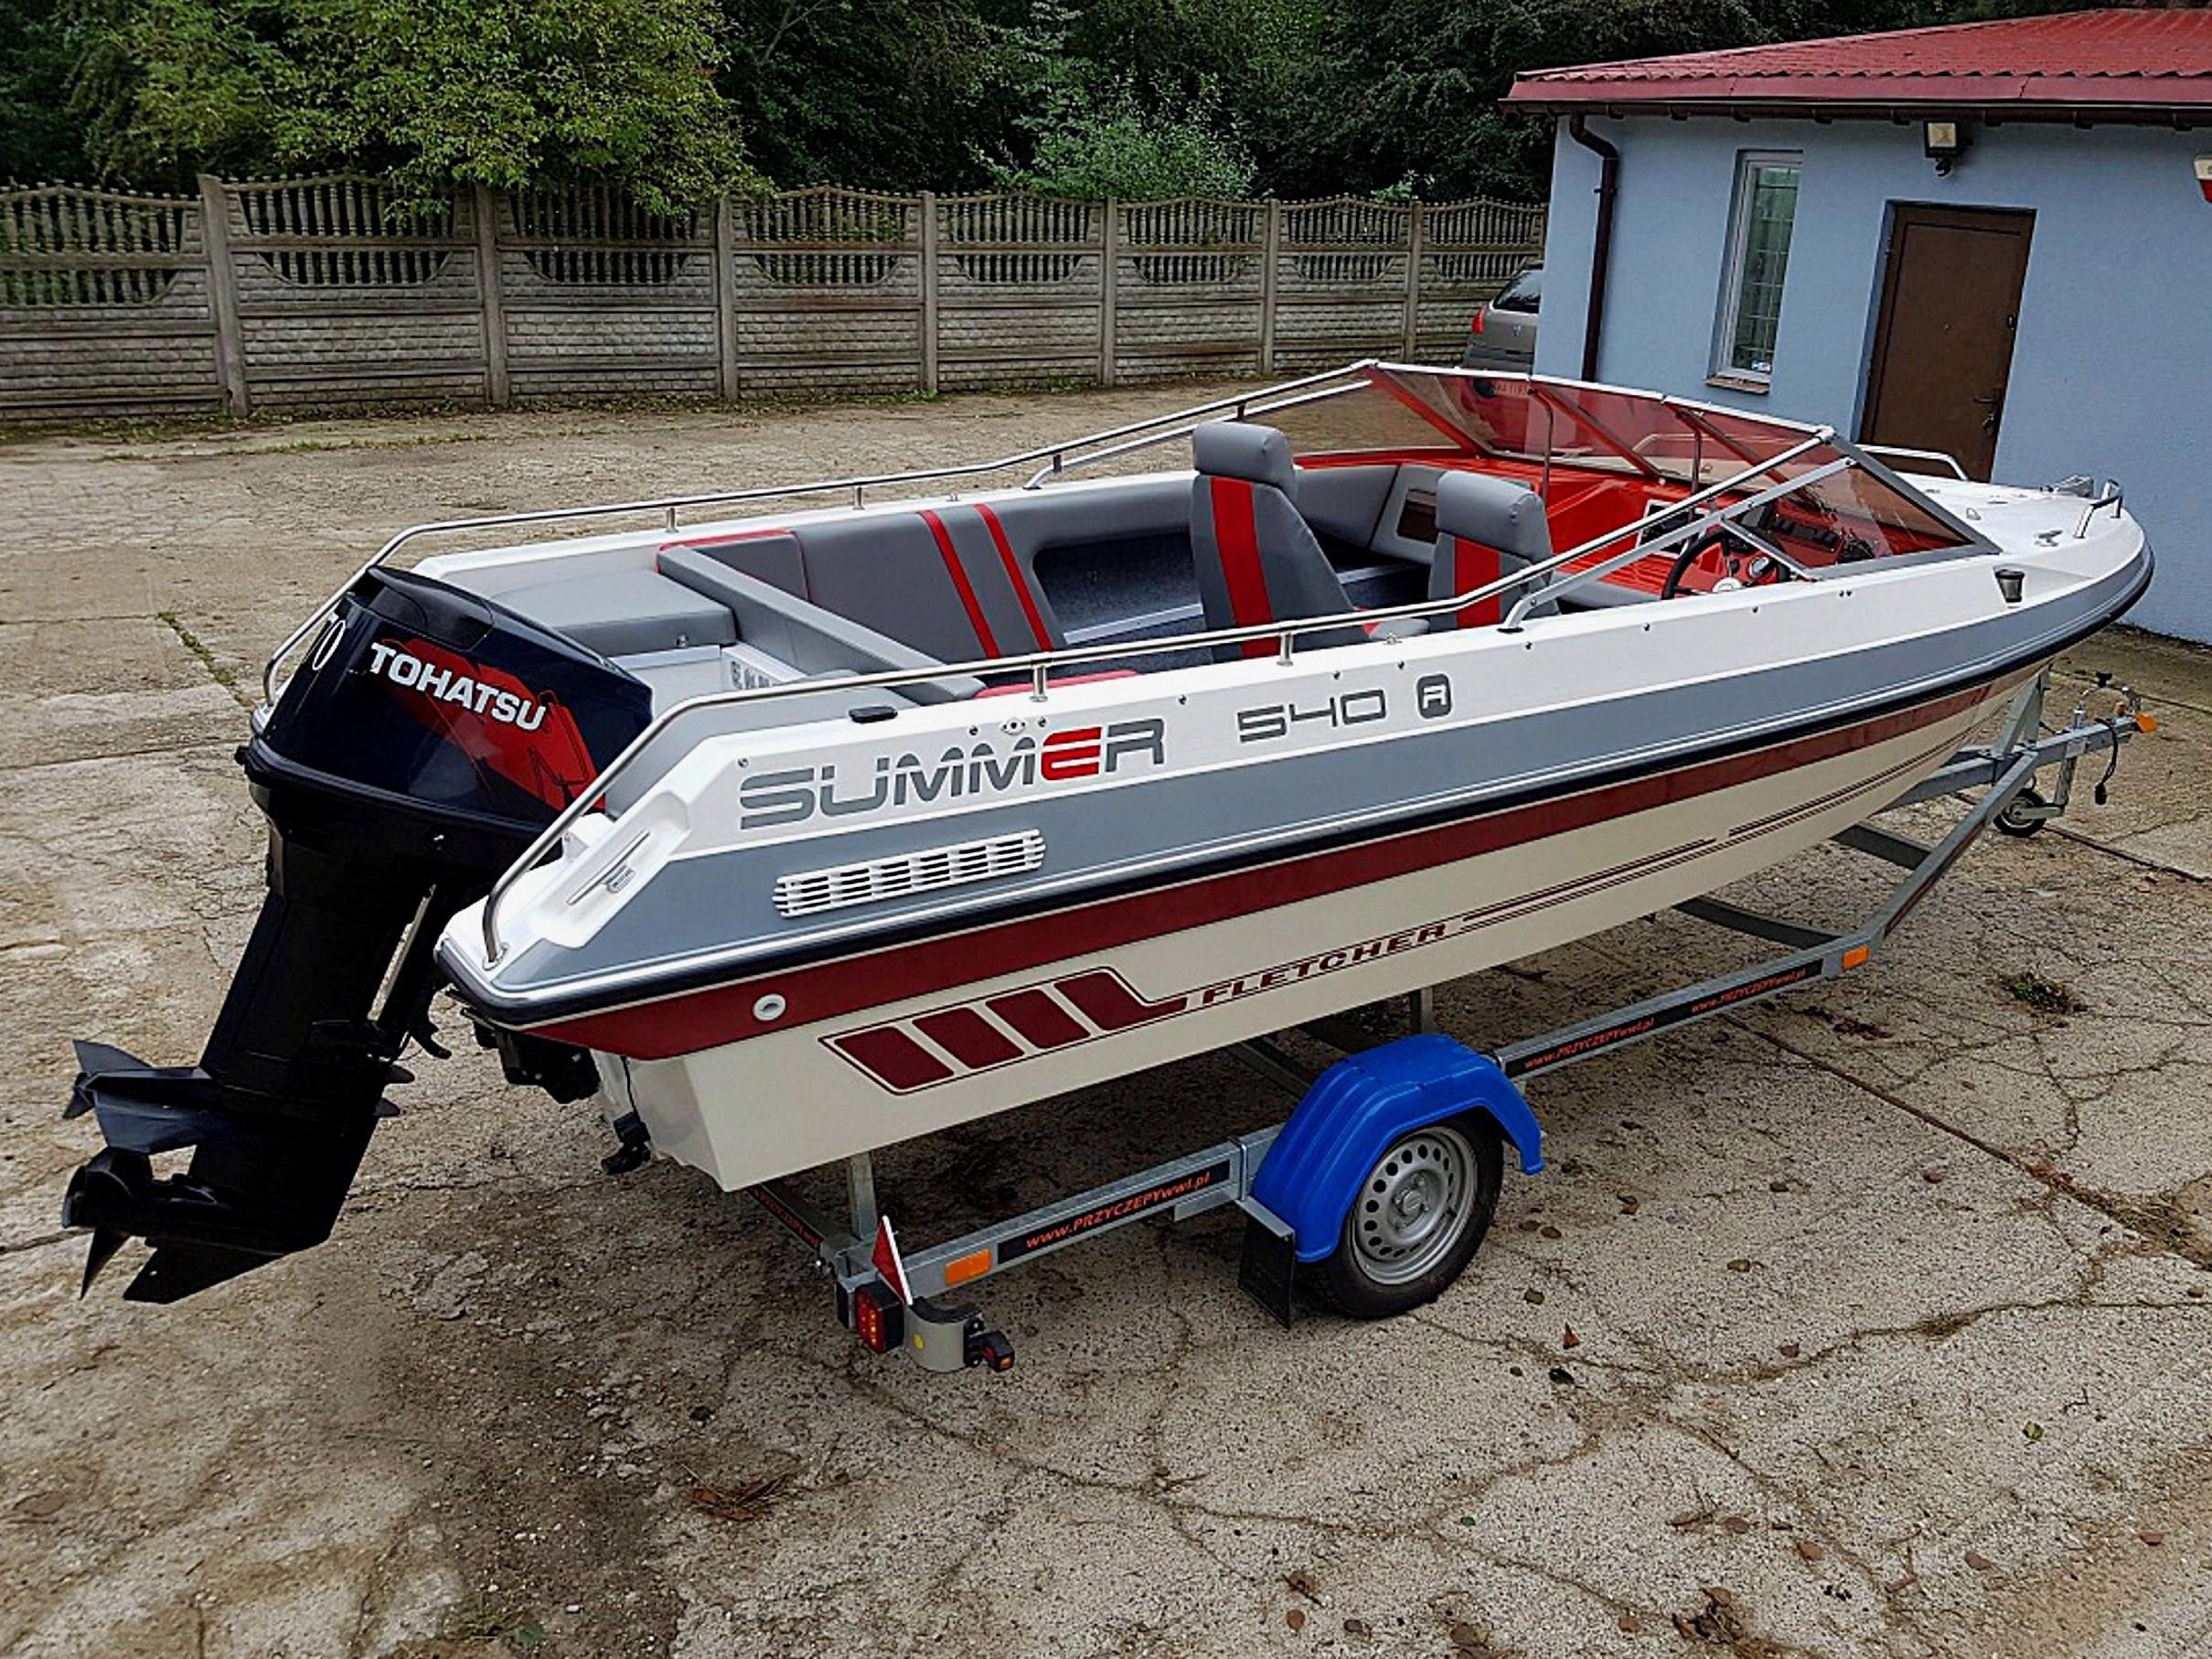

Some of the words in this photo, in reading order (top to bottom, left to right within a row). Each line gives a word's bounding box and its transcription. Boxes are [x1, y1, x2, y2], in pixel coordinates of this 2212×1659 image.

[369, 642, 547, 731] TOHATSU
[740, 718, 1164, 830] SUMMER
[1236, 689, 1386, 743] 540
[1202, 923, 1446, 1004] FLETCHER
